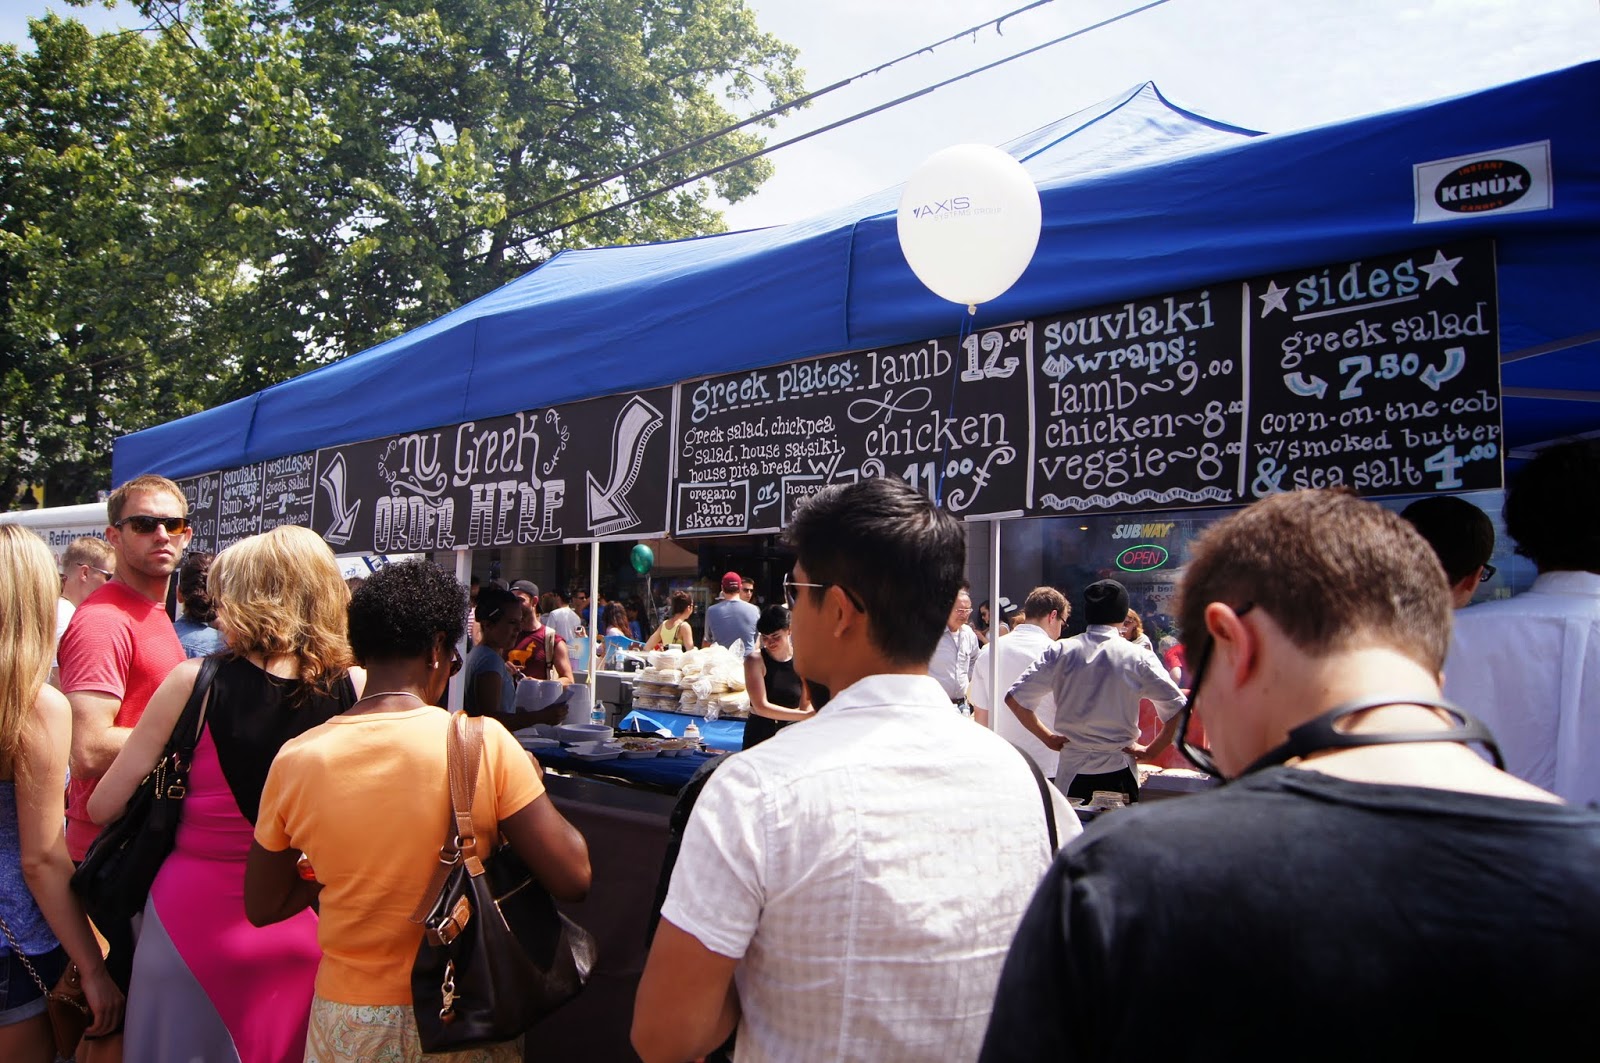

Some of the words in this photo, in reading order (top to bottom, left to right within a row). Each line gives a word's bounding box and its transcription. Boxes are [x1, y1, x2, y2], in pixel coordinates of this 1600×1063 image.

[921, 197, 970, 218] AXIS
[1295, 258, 1419, 312] sides
[1044, 290, 1215, 354] souvlaki
[1280, 319, 1386, 370] greek
[1391, 302, 1490, 345] salad
[691, 371, 770, 423] greek
[867, 339, 952, 389] lamb
[1339, 353, 1420, 400] 7.50
[771, 415, 836, 437] chickpea
[865, 410, 1009, 457] chicken
[1401, 423, 1501, 448] butter
[453, 412, 541, 490] Greek
[741, 441, 780, 461] house
[224, 463, 262, 487] souvlaki
[275, 455, 303, 475] sides
[690, 466, 727, 484] house
[729, 461, 759, 483] pita
[761, 457, 802, 476] bread
[1251, 457, 1288, 498] &
[1292, 465, 1344, 491] sea
[1352, 457, 1422, 489] salt
[1424, 442, 1497, 490] 4.00
[265, 479, 287, 499] greek
[288, 473, 310, 491] salad
[689, 487, 737, 501] oregano
[786, 482, 822, 495] honey
[374, 496, 456, 553] ORDER
[468, 480, 566, 547] HERE
[686, 513, 745, 528] skewer
[695, 501, 732, 515] lamb
[1112, 522, 1175, 540] SUBWAY
[1123, 551, 1160, 565] OPEN
